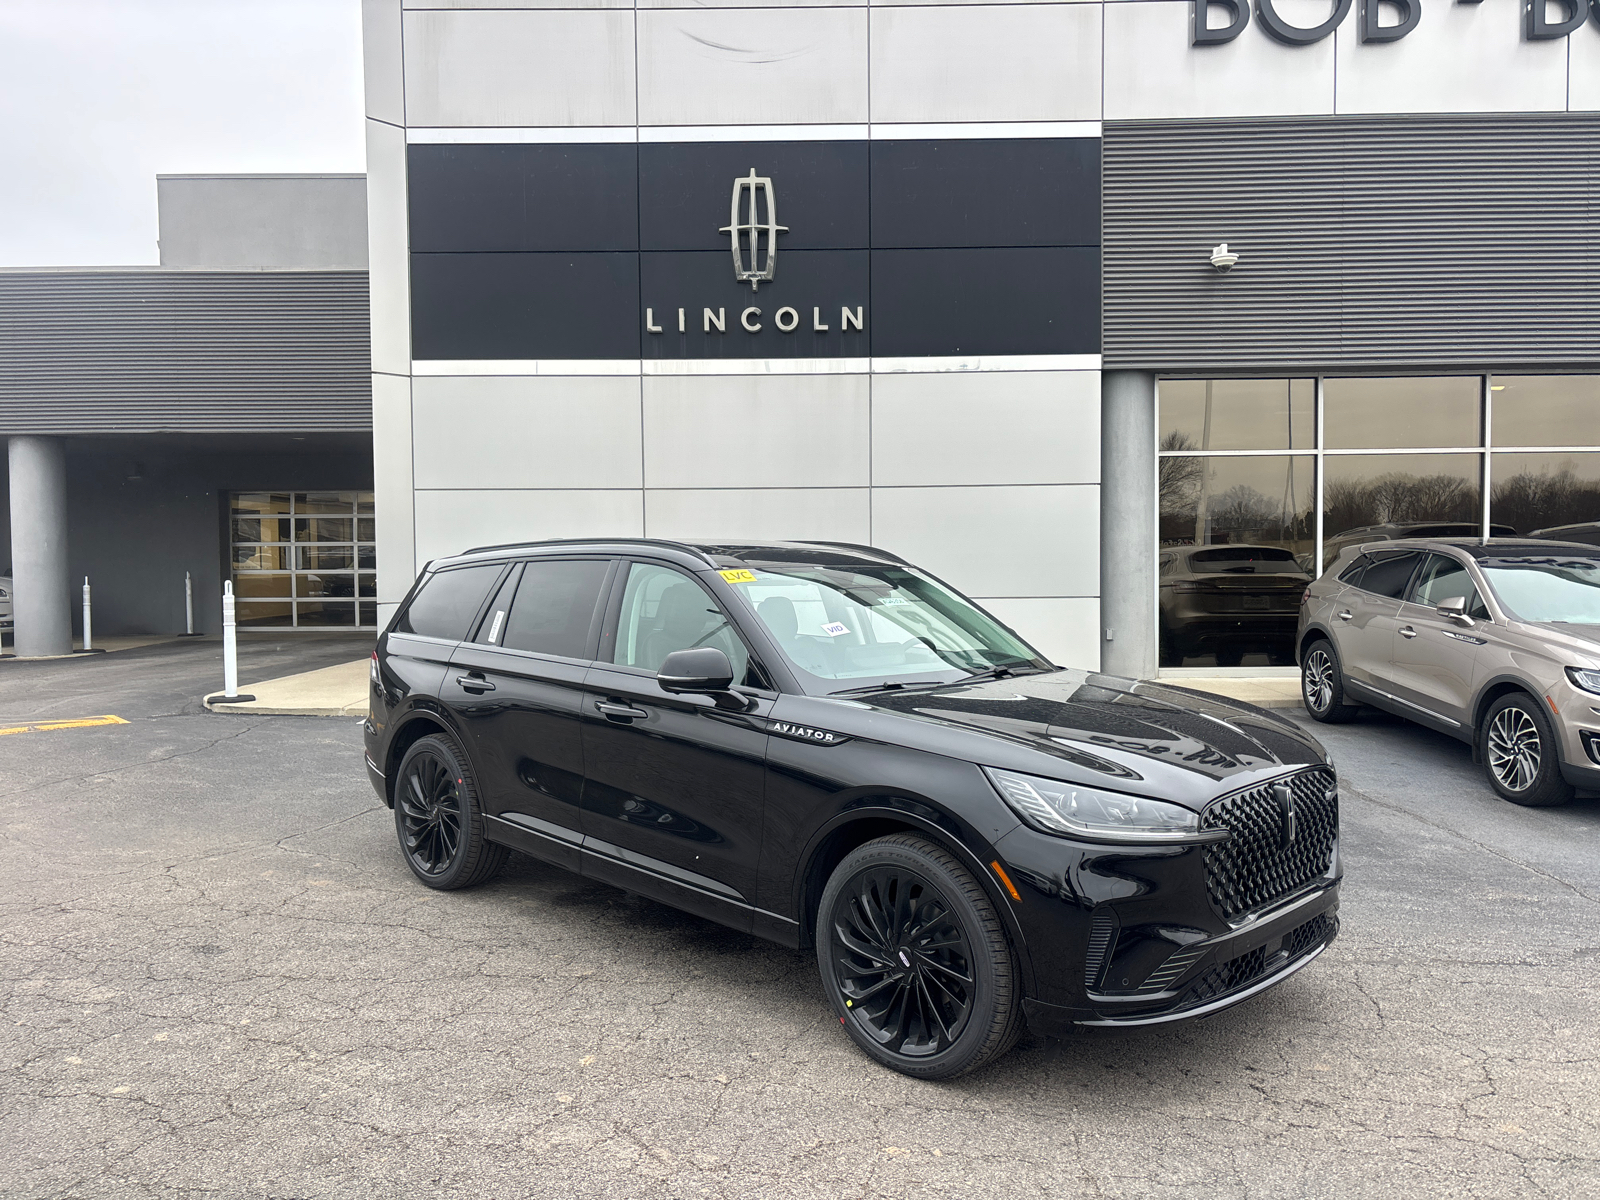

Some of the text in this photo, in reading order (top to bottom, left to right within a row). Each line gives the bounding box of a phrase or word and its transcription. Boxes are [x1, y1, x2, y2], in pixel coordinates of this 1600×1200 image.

[646, 306, 864, 333] LINCOLN
[723, 571, 752, 581] LVC
[826, 625, 844, 633] VID
[773, 722, 834, 742] AVIATOR
[848, 852, 884, 870] EAGLE
